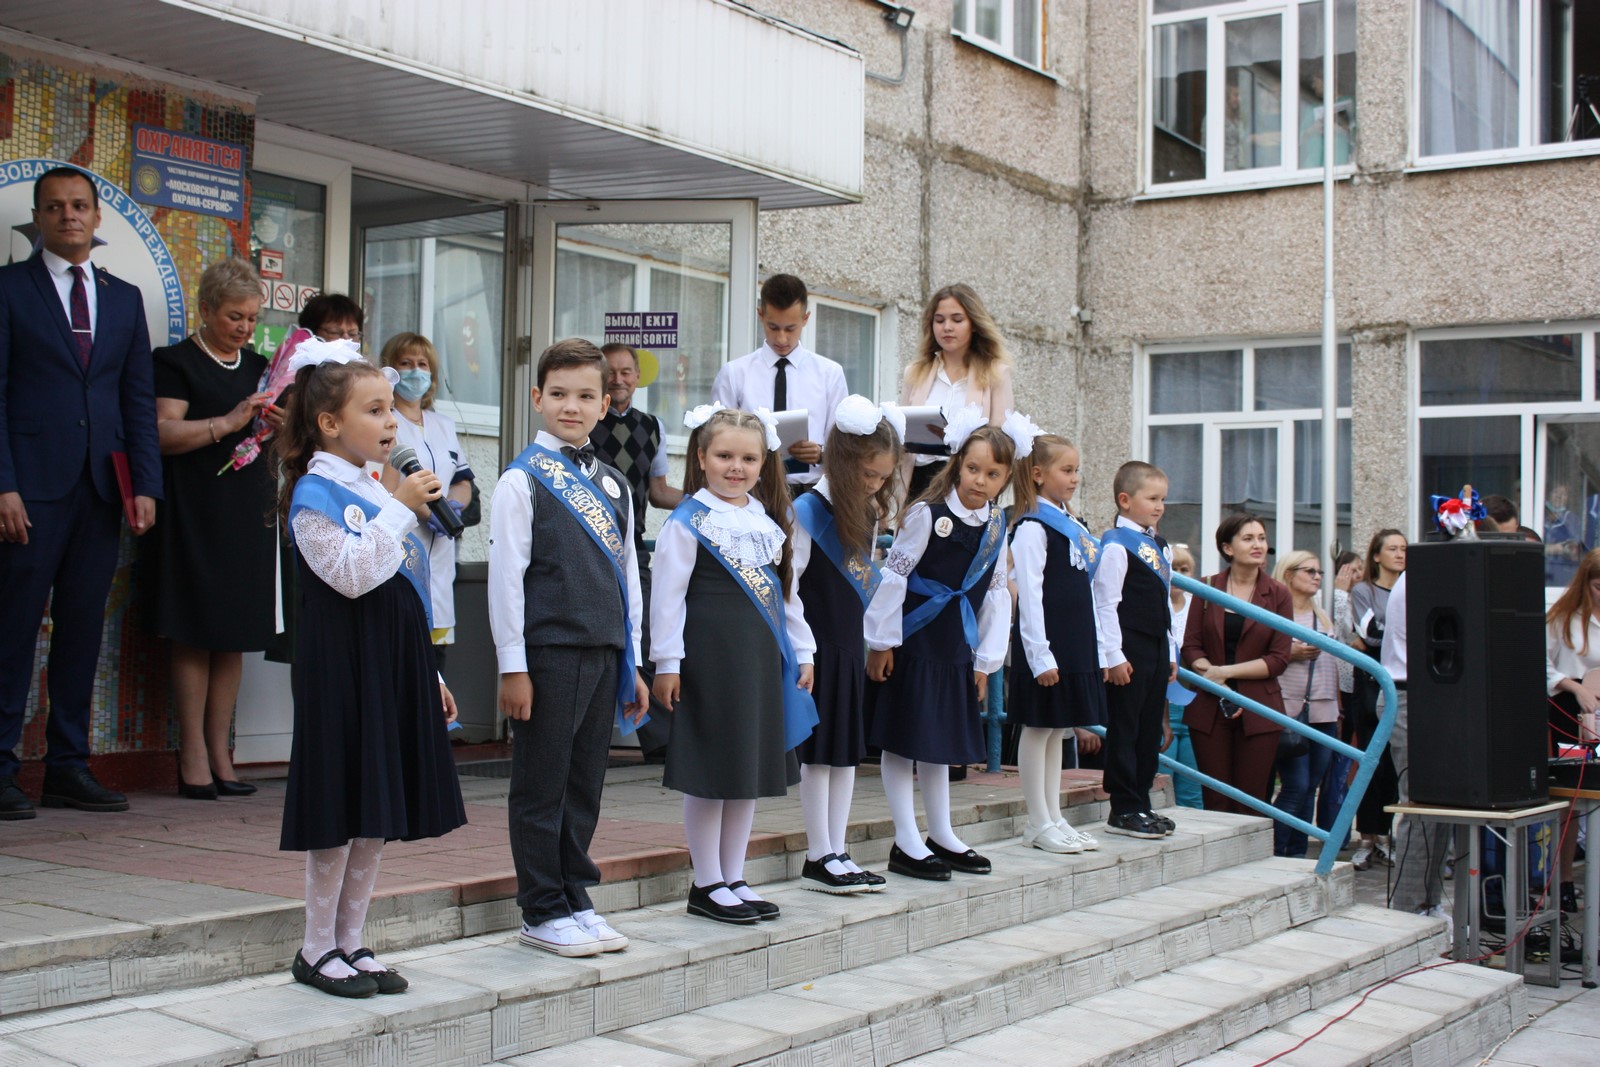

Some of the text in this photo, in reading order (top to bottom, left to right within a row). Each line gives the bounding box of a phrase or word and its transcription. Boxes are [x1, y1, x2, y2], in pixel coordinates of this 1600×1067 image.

[136, 128, 242, 170] ОХРАНЯЕТСЯ
[123, 202, 182, 328] УЧРЕЖДЕНИЕ
[605, 315, 640, 328] ВЫХОД
[645, 315, 674, 327] EXIT
[605, 333, 640, 345] AUSGANG
[643, 333, 677, 345] SORTIE
